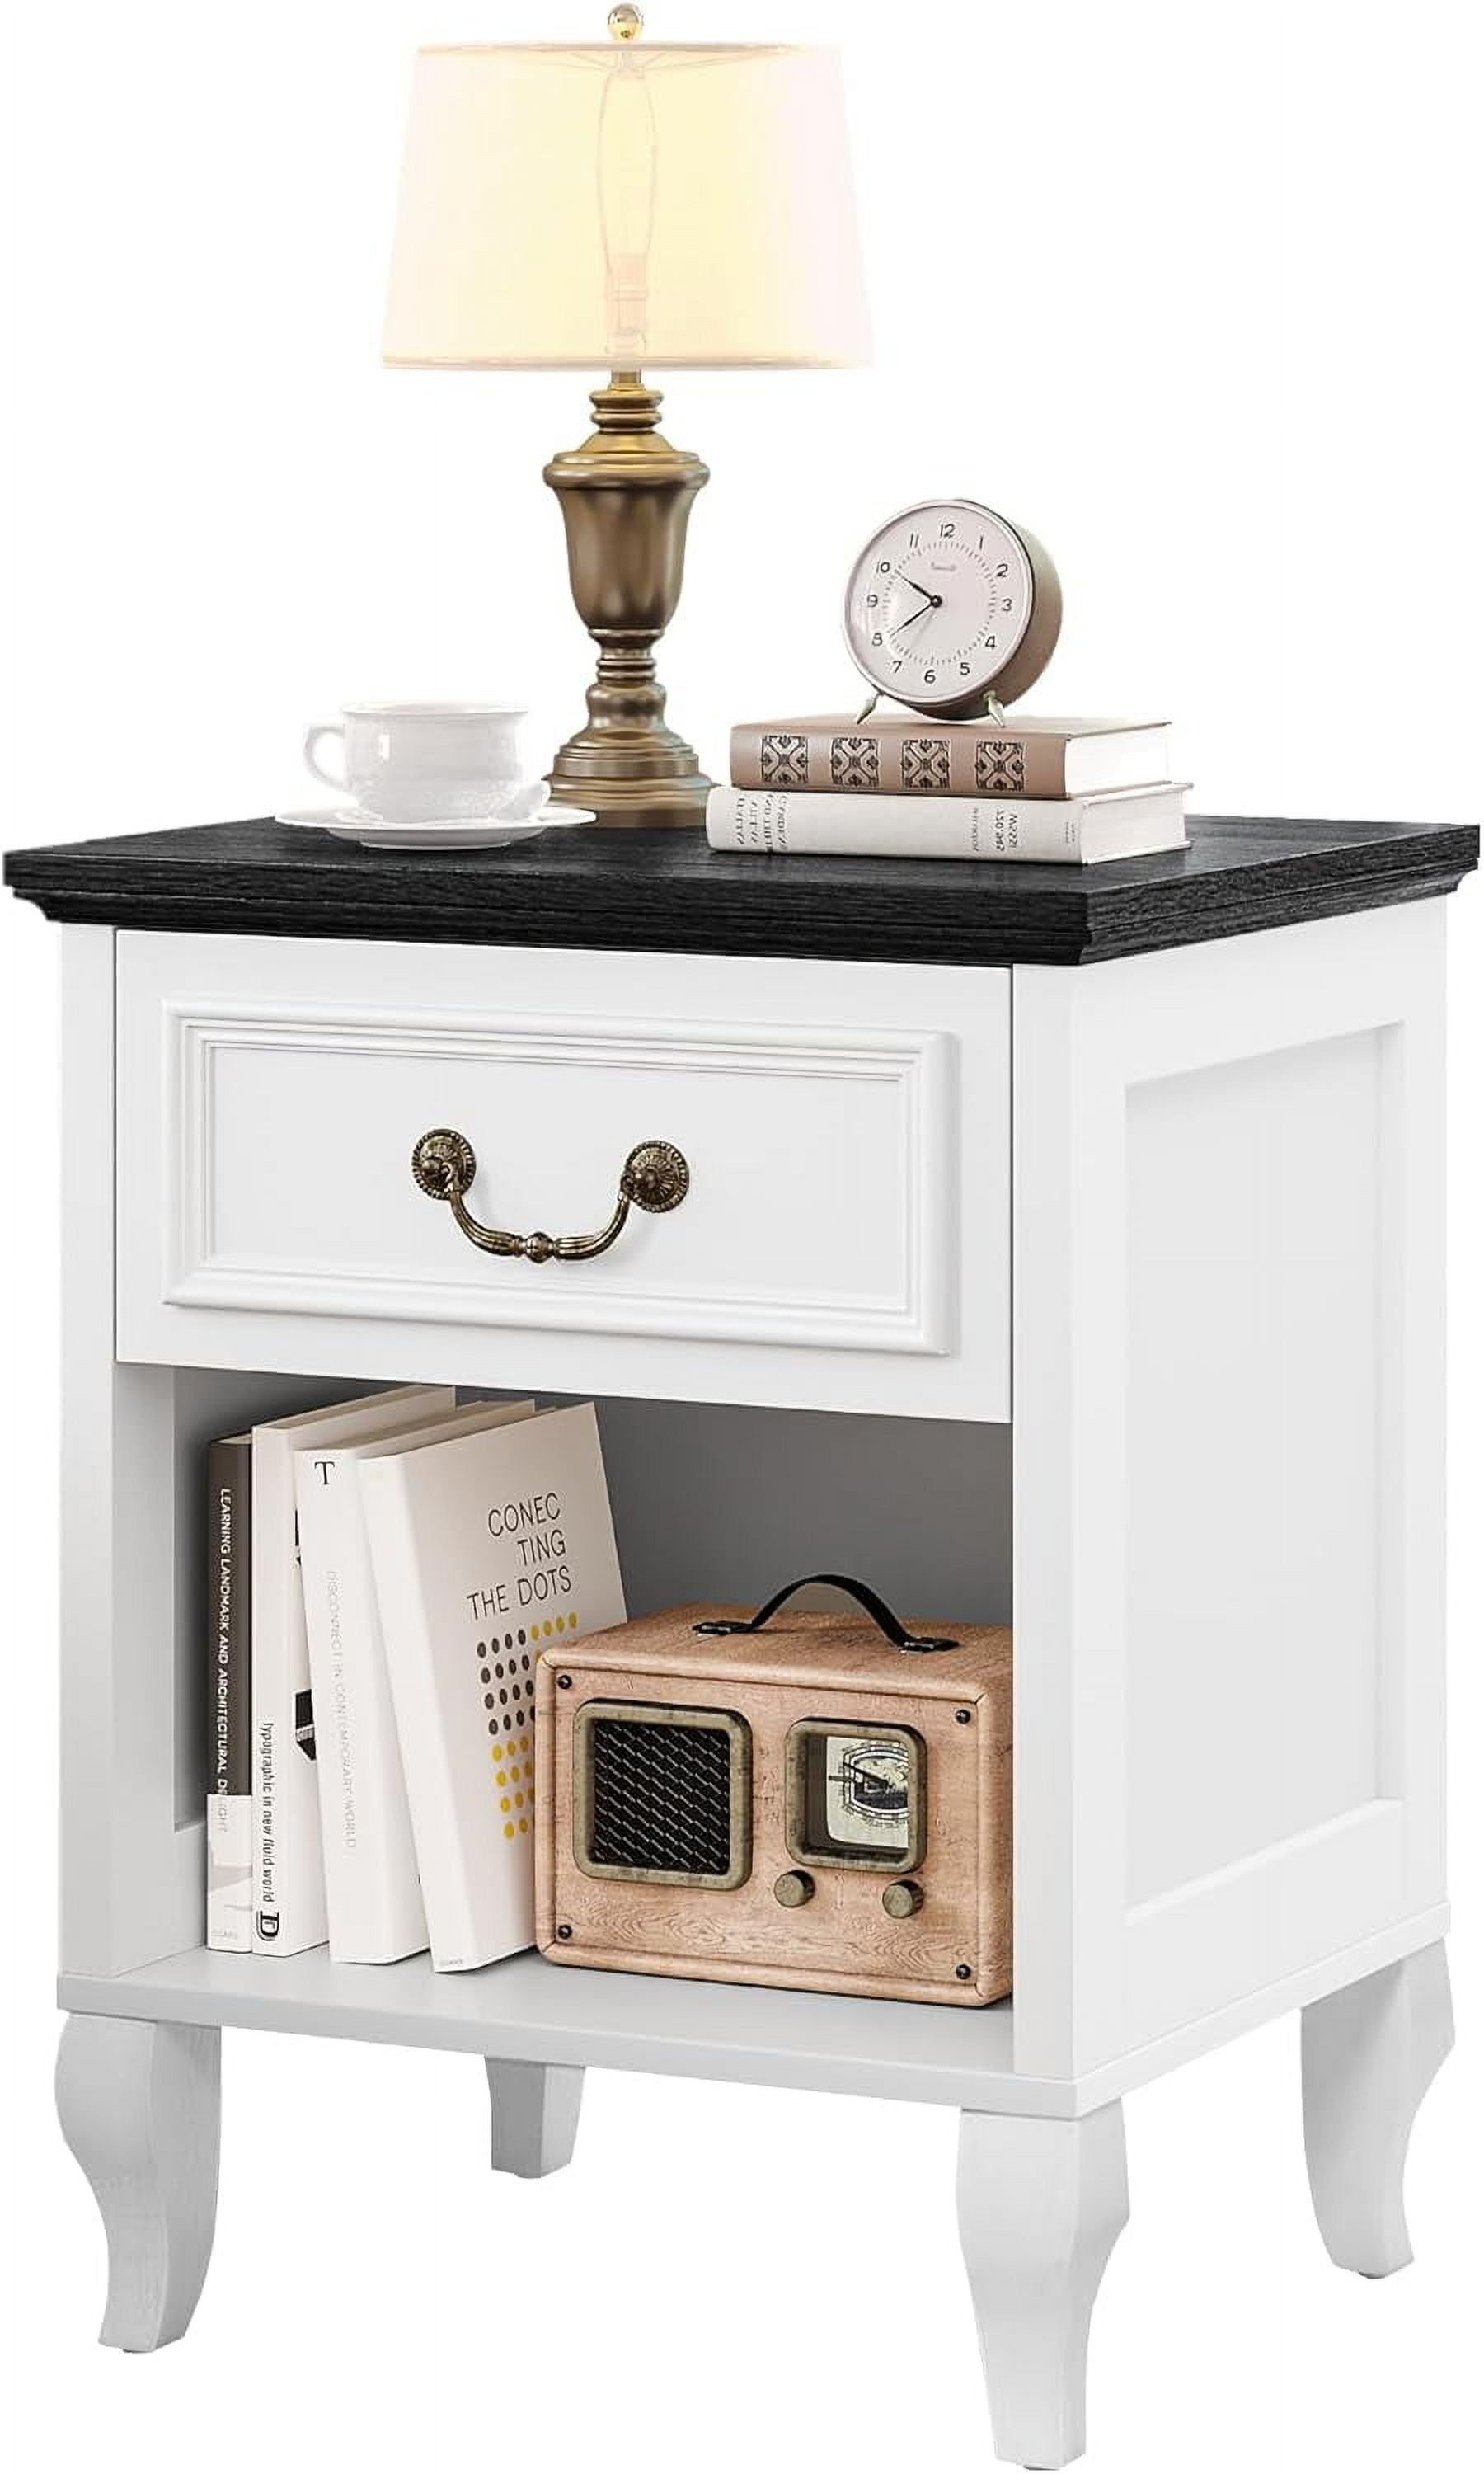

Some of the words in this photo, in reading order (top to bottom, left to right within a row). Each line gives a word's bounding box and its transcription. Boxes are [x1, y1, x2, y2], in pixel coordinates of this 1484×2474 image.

[940, 524, 956, 539] 12
[910, 533, 919, 548] 11
[876, 562, 890, 573] 10
[996, 563, 1009, 578] 2
[866, 594, 878, 608] 9
[1002, 599, 1012, 612] 3
[871, 632, 883, 647] 8
[985, 635, 996, 649] 4
[892, 660, 903, 674] 7
[960, 662, 970, 675] 5
[924, 669, 936, 684] 6
[314, 1460, 336, 1485] T
[220, 1488, 232, 1554] LEARNING
[488, 1492, 561, 1536] CONEC
[517, 1529, 566, 1566] TING
[218, 1559, 232, 1631] LANDMARK
[467, 1584, 509, 1620] THE
[517, 1565, 571, 1606] DOTS
[218, 1634, 229, 1664] AND
[217, 1667, 228, 1774] ARCHITECTURAL
[263, 1795, 275, 1806] in
[262, 1810, 273, 1835] new
[262, 1869, 275, 1903] world
